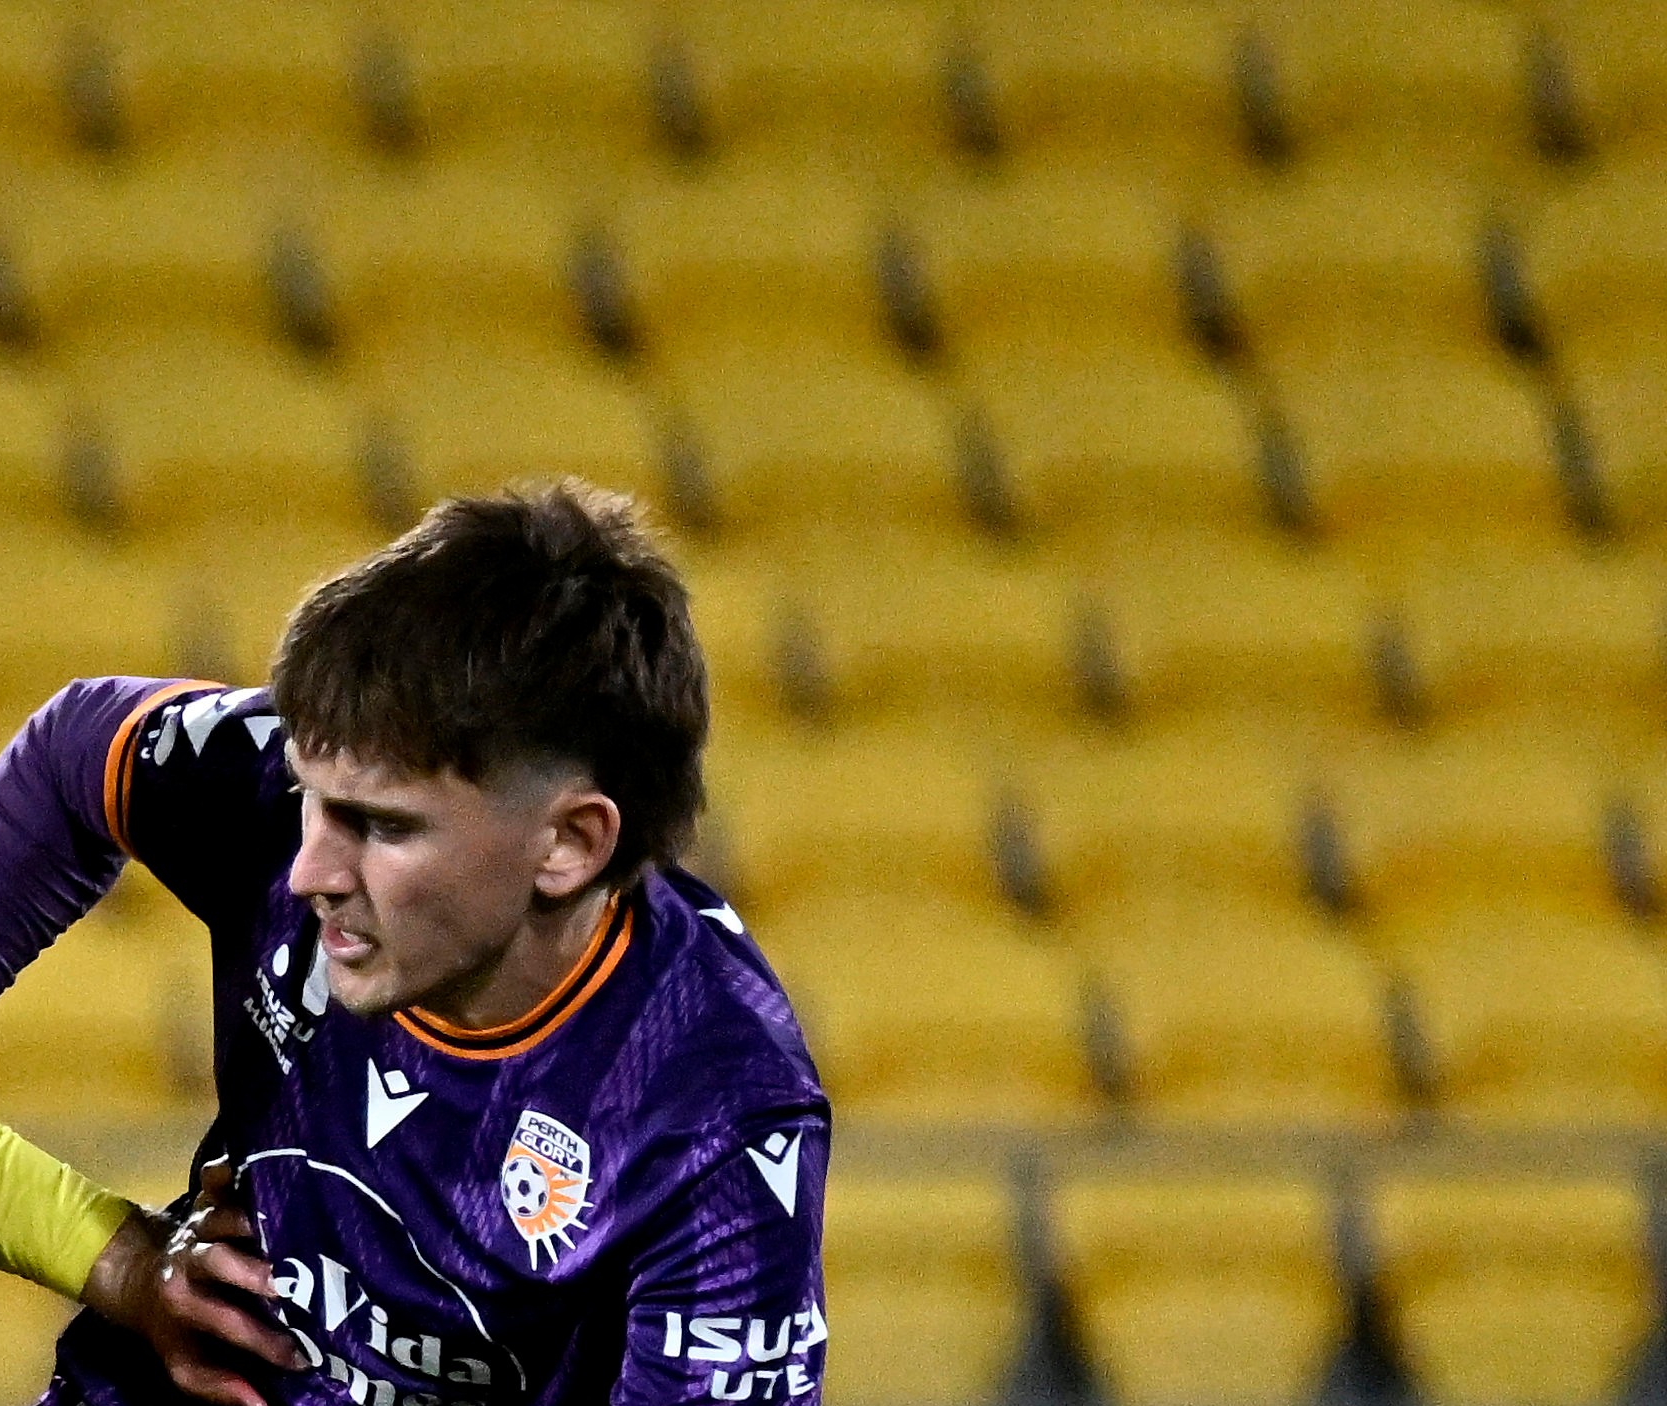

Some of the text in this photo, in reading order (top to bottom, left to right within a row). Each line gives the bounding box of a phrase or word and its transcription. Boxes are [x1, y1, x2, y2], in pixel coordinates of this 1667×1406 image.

[520, 1131, 578, 1168] GLORY
[527, 1117, 579, 1154] PERTH
[258, 1225, 491, 1385] aVida
[710, 1363, 816, 1402] UTE
